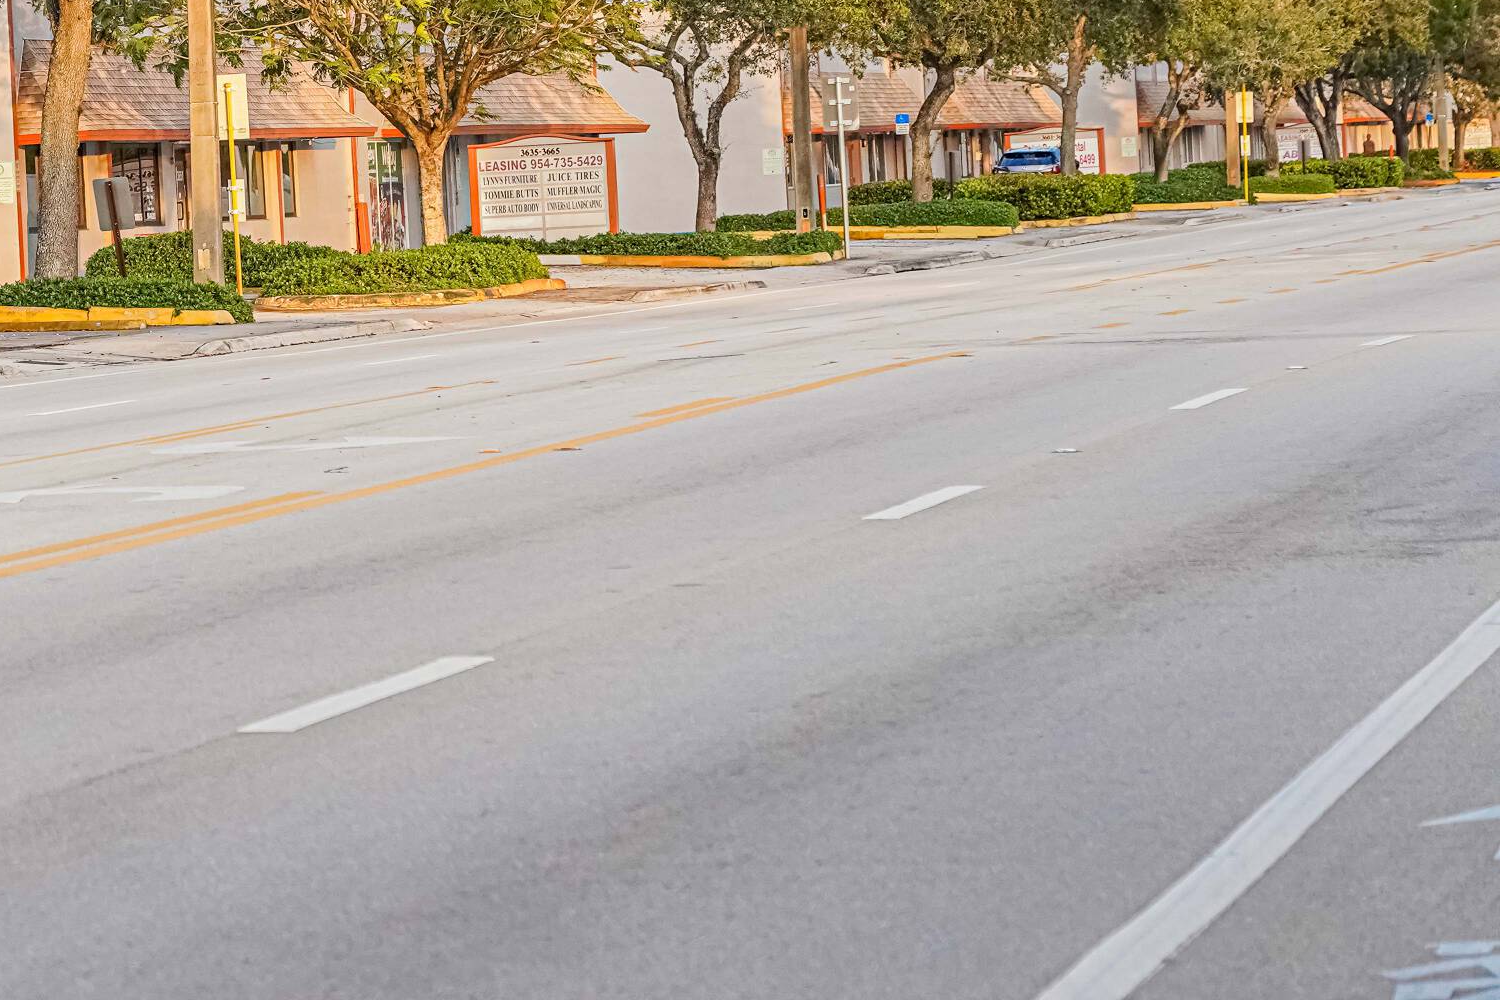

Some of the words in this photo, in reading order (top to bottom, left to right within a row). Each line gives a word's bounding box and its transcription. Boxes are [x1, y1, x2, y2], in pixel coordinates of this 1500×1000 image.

[520, 147, 560, 157] 3635-3665
[479, 159, 527, 172] LEASING
[530, 155, 603, 169] 954-735-5429
[504, 174, 538, 185] FURNITURE
[547, 172, 573, 182] JUICE
[574, 171, 600, 181] TIRES
[484, 190, 515, 200] TOMMIE
[515, 188, 539, 199] BUTTS
[547, 186, 579, 196] MUFFLER
[579, 185, 602, 195] MAGIC
[507, 204, 523, 214] AUTO
